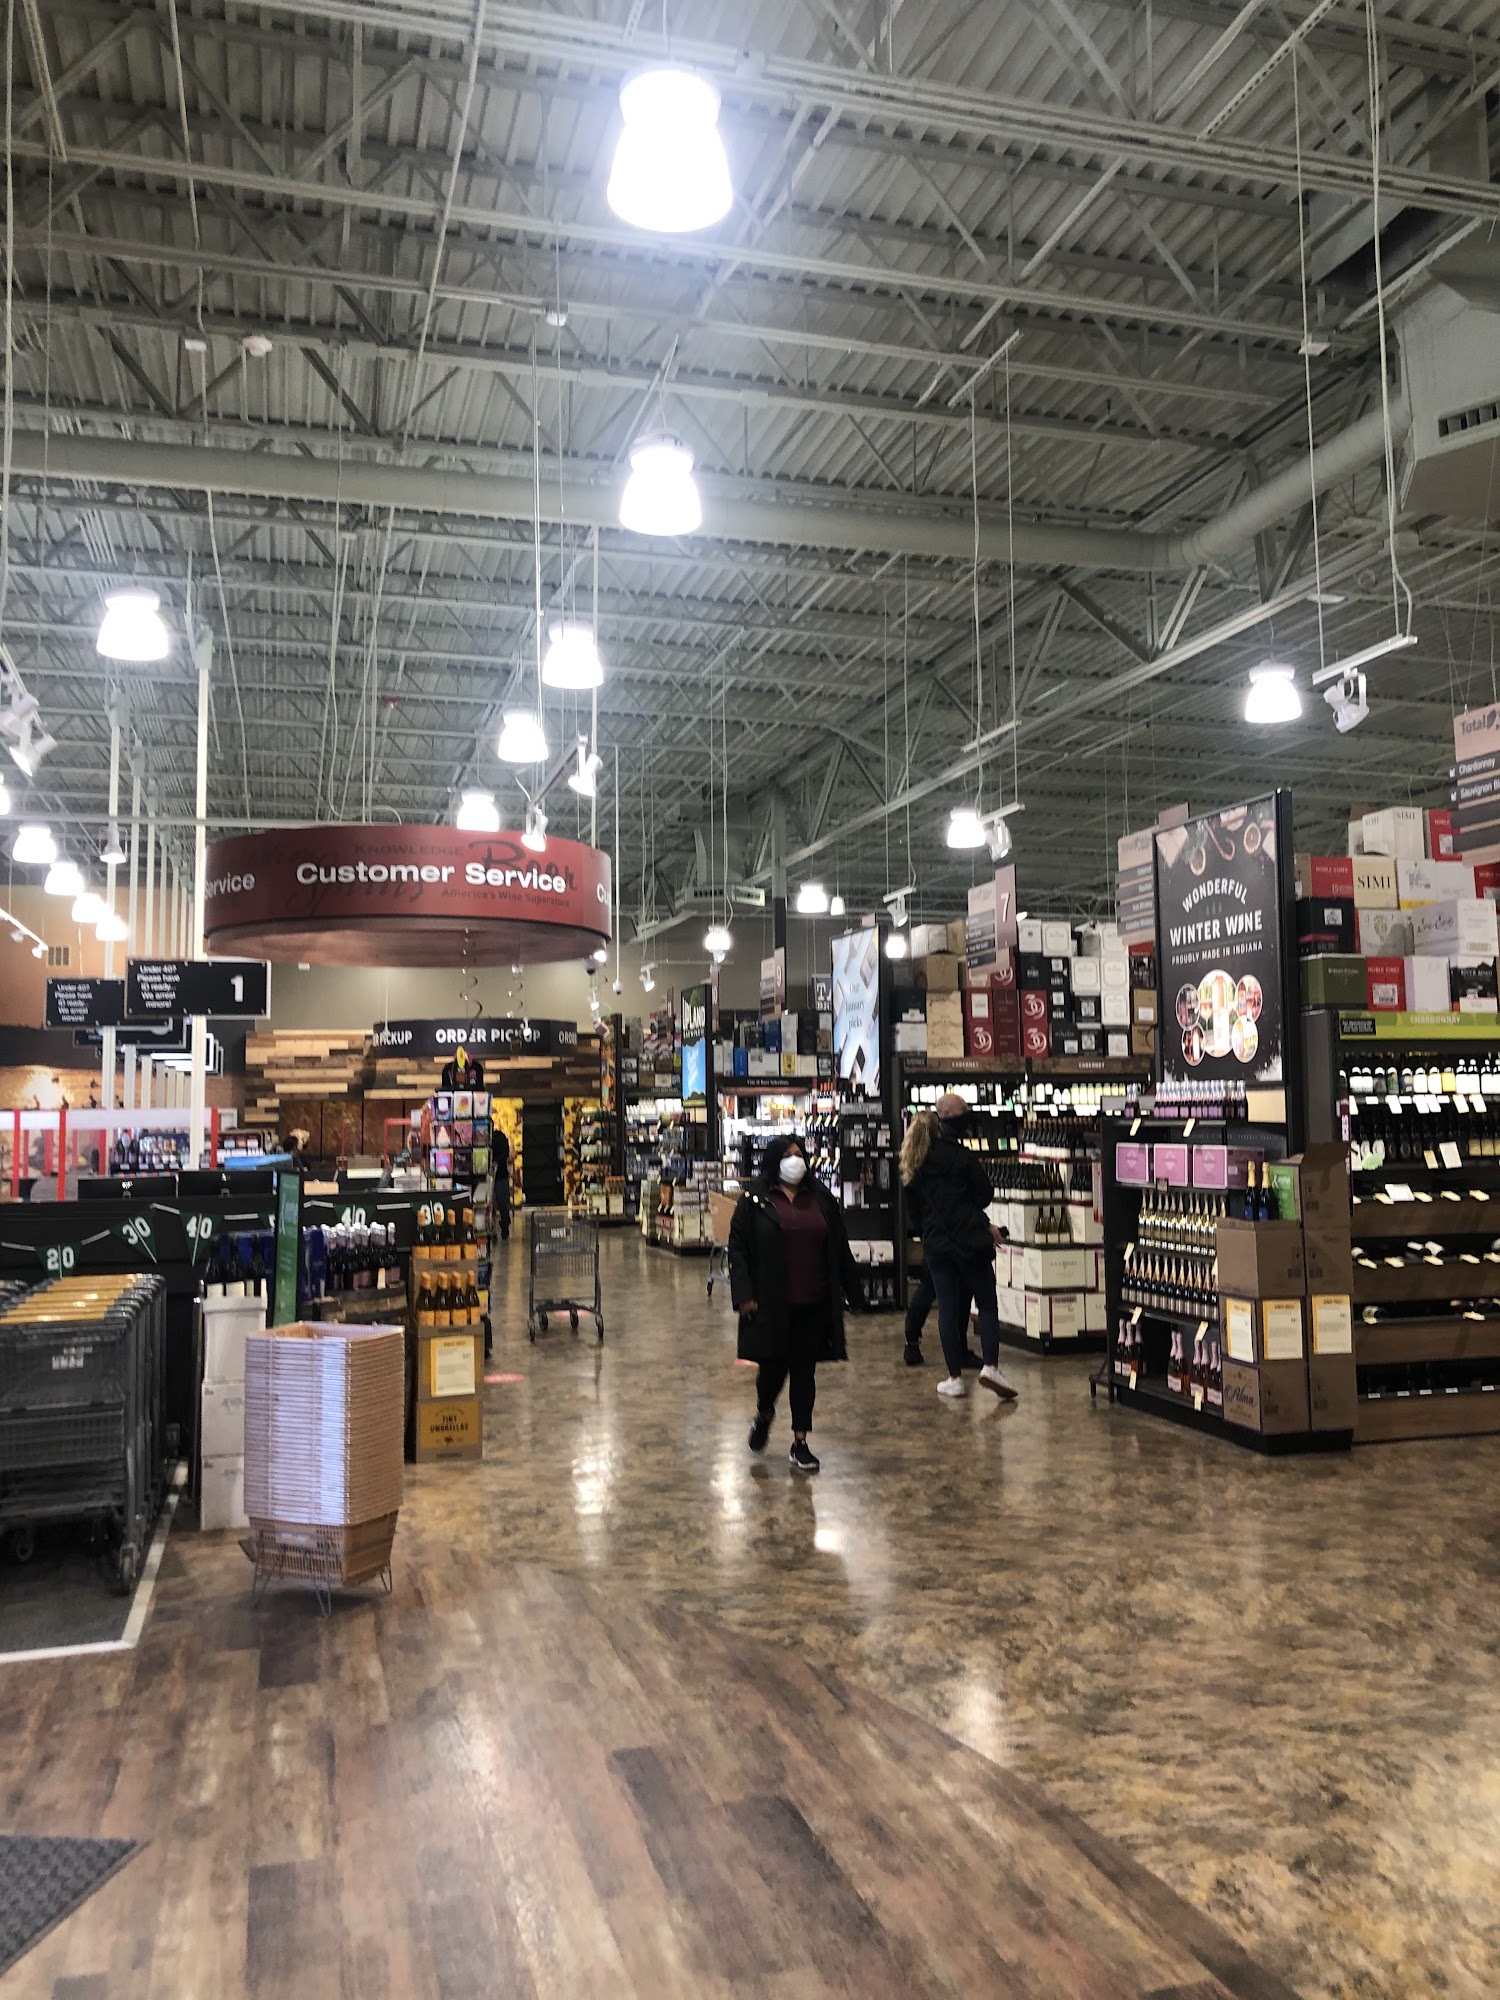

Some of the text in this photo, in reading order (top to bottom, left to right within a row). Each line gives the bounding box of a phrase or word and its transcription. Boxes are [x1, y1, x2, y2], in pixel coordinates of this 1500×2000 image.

[1460, 715, 1486, 736] Total
[1459, 758, 1495, 775] Chardonnay
[1460, 782, 1492, 800] Sauvignon
[204, 872, 255, 900] ervice
[296, 861, 456, 885] Customer
[465, 862, 566, 893] Service
[1357, 875, 1391, 889] SIMI
[1182, 877, 1247, 913] WONDERFUL
[1000, 892, 1010, 923] 7
[1169, 918, 1220, 947] WINTER
[1225, 909, 1262, 937] WINE
[1171, 940, 1262, 966] PROUDLY MADE IN INDIANA
[137, 974, 181, 982] Please have
[139, 965, 161, 973] Under
[776, 965, 782, 987] 9
[230, 974, 244, 1002] 1
[682, 996, 705, 1030] UPLAND
[1410, 1015, 1461, 1024] CHARDONNAY
[1078, 1061, 1105, 1069] CABERNET
[186, 1216, 213, 1240] 40
[341, 1207, 366, 1226] 40
[122, 1216, 151, 1245] 30
[46, 1246, 75, 1271] 20
